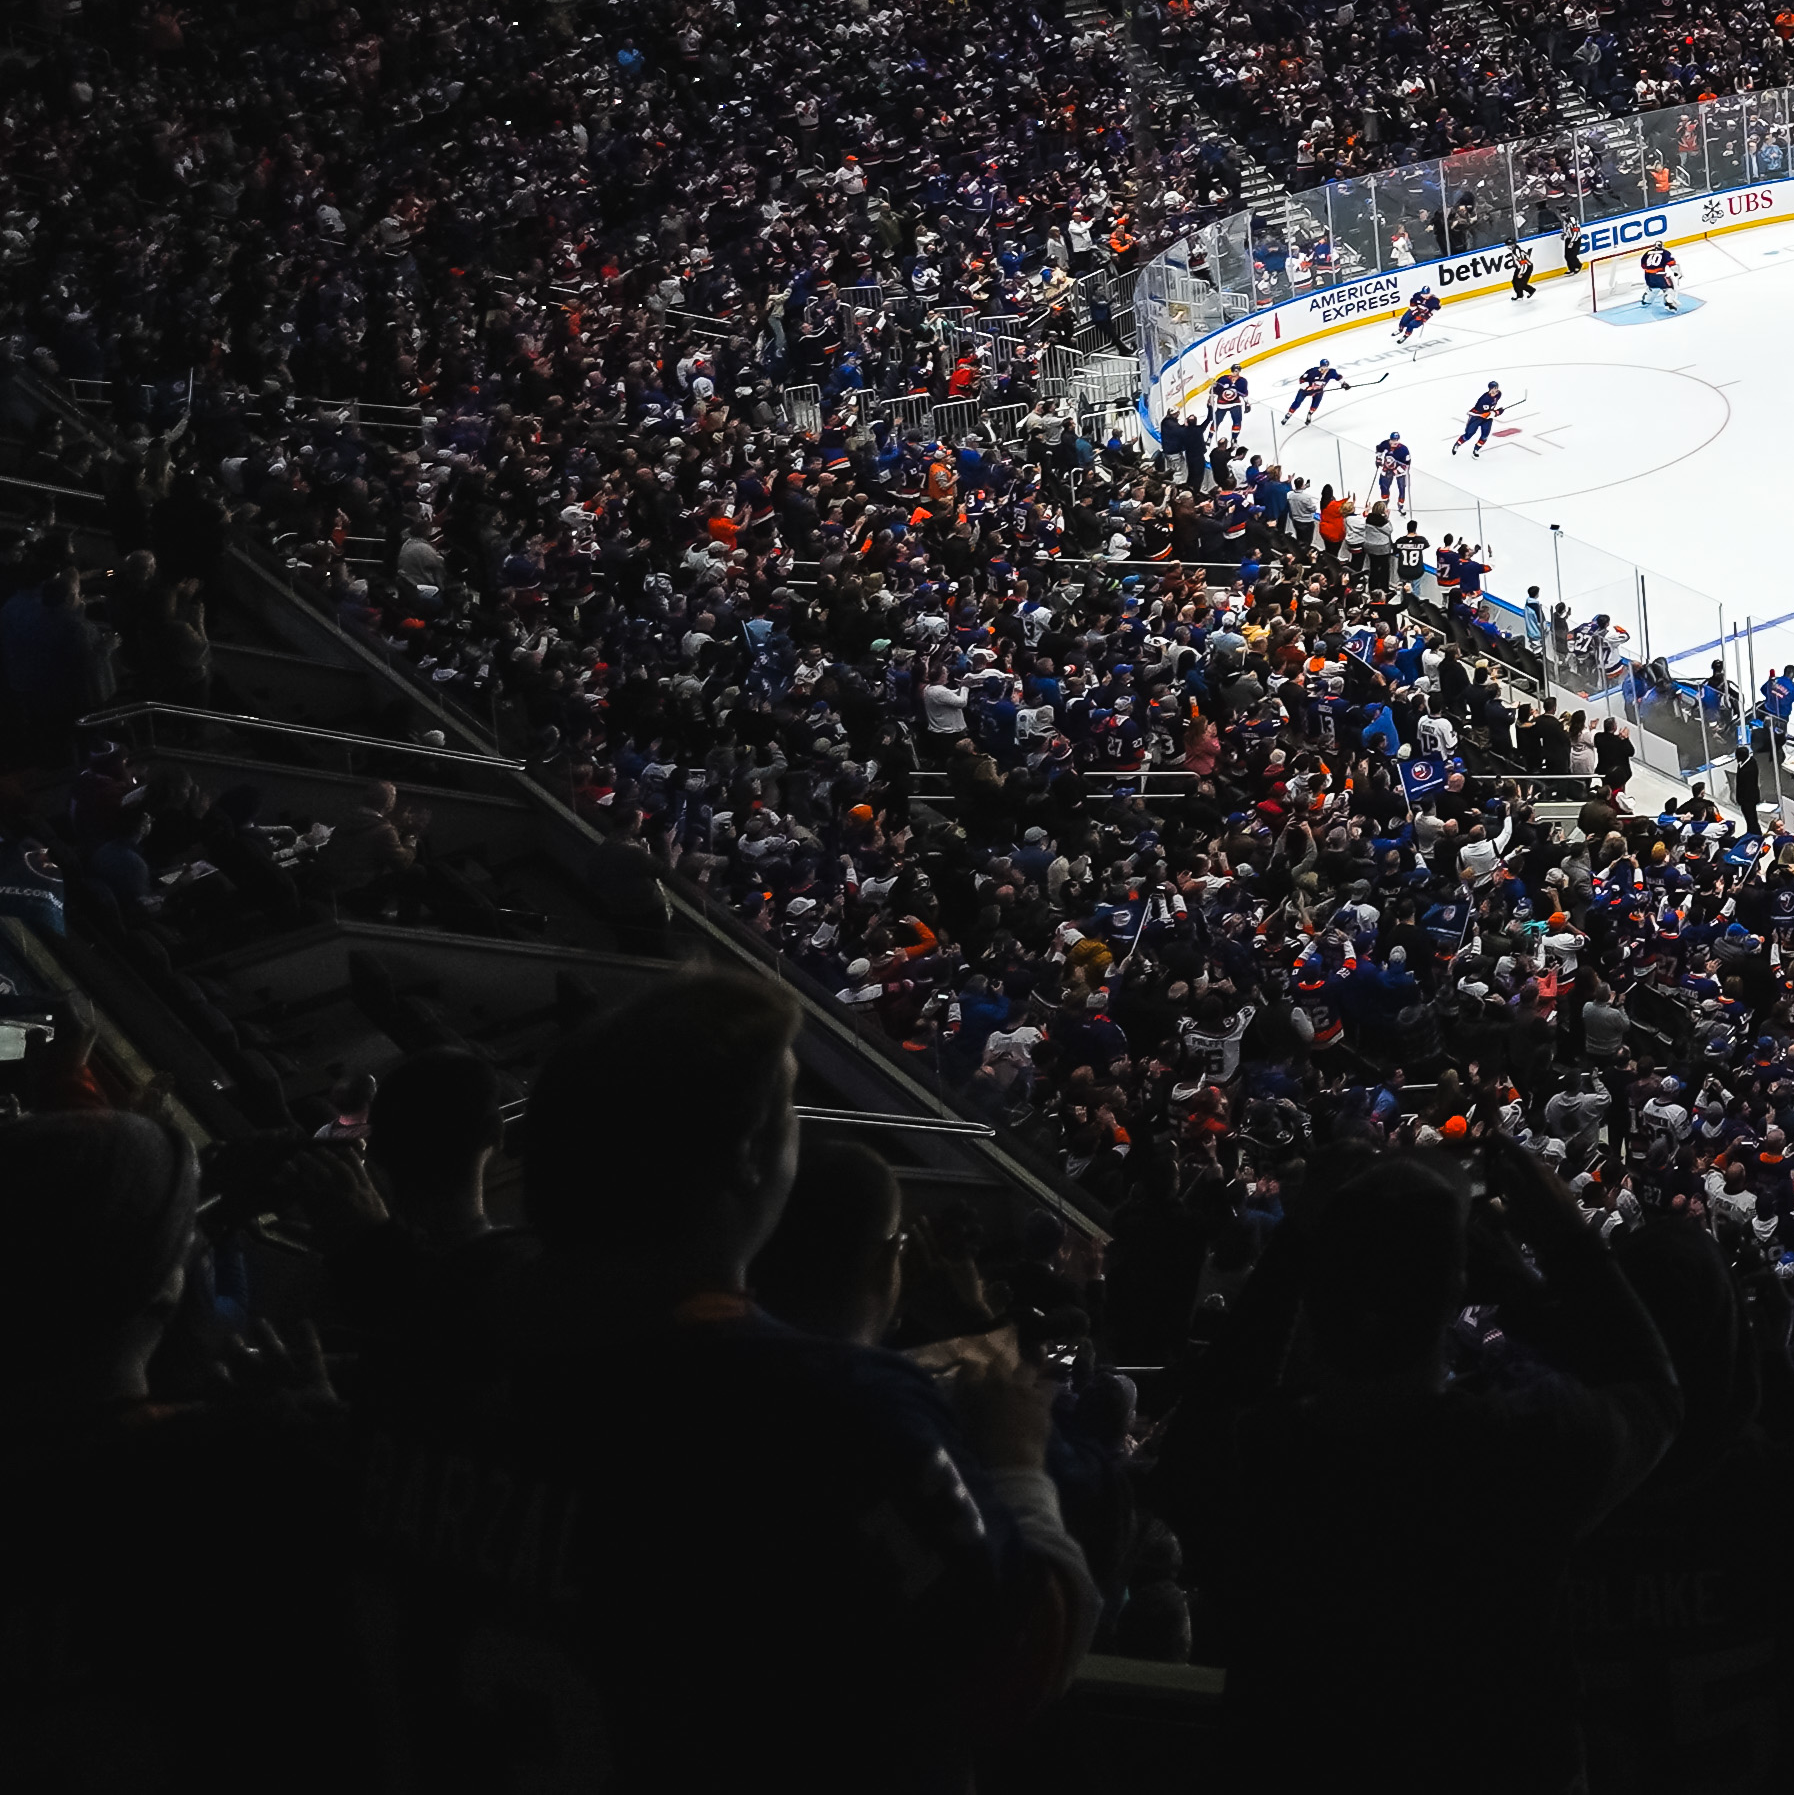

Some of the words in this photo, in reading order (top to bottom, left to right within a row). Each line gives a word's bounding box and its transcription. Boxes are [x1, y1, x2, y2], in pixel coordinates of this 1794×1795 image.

[1727, 190, 1773, 216] UBS
[1578, 214, 1668, 255] GEICO
[1309, 276, 1399, 313] AMERICAN
[1322, 291, 1401, 323] EXPRESS
